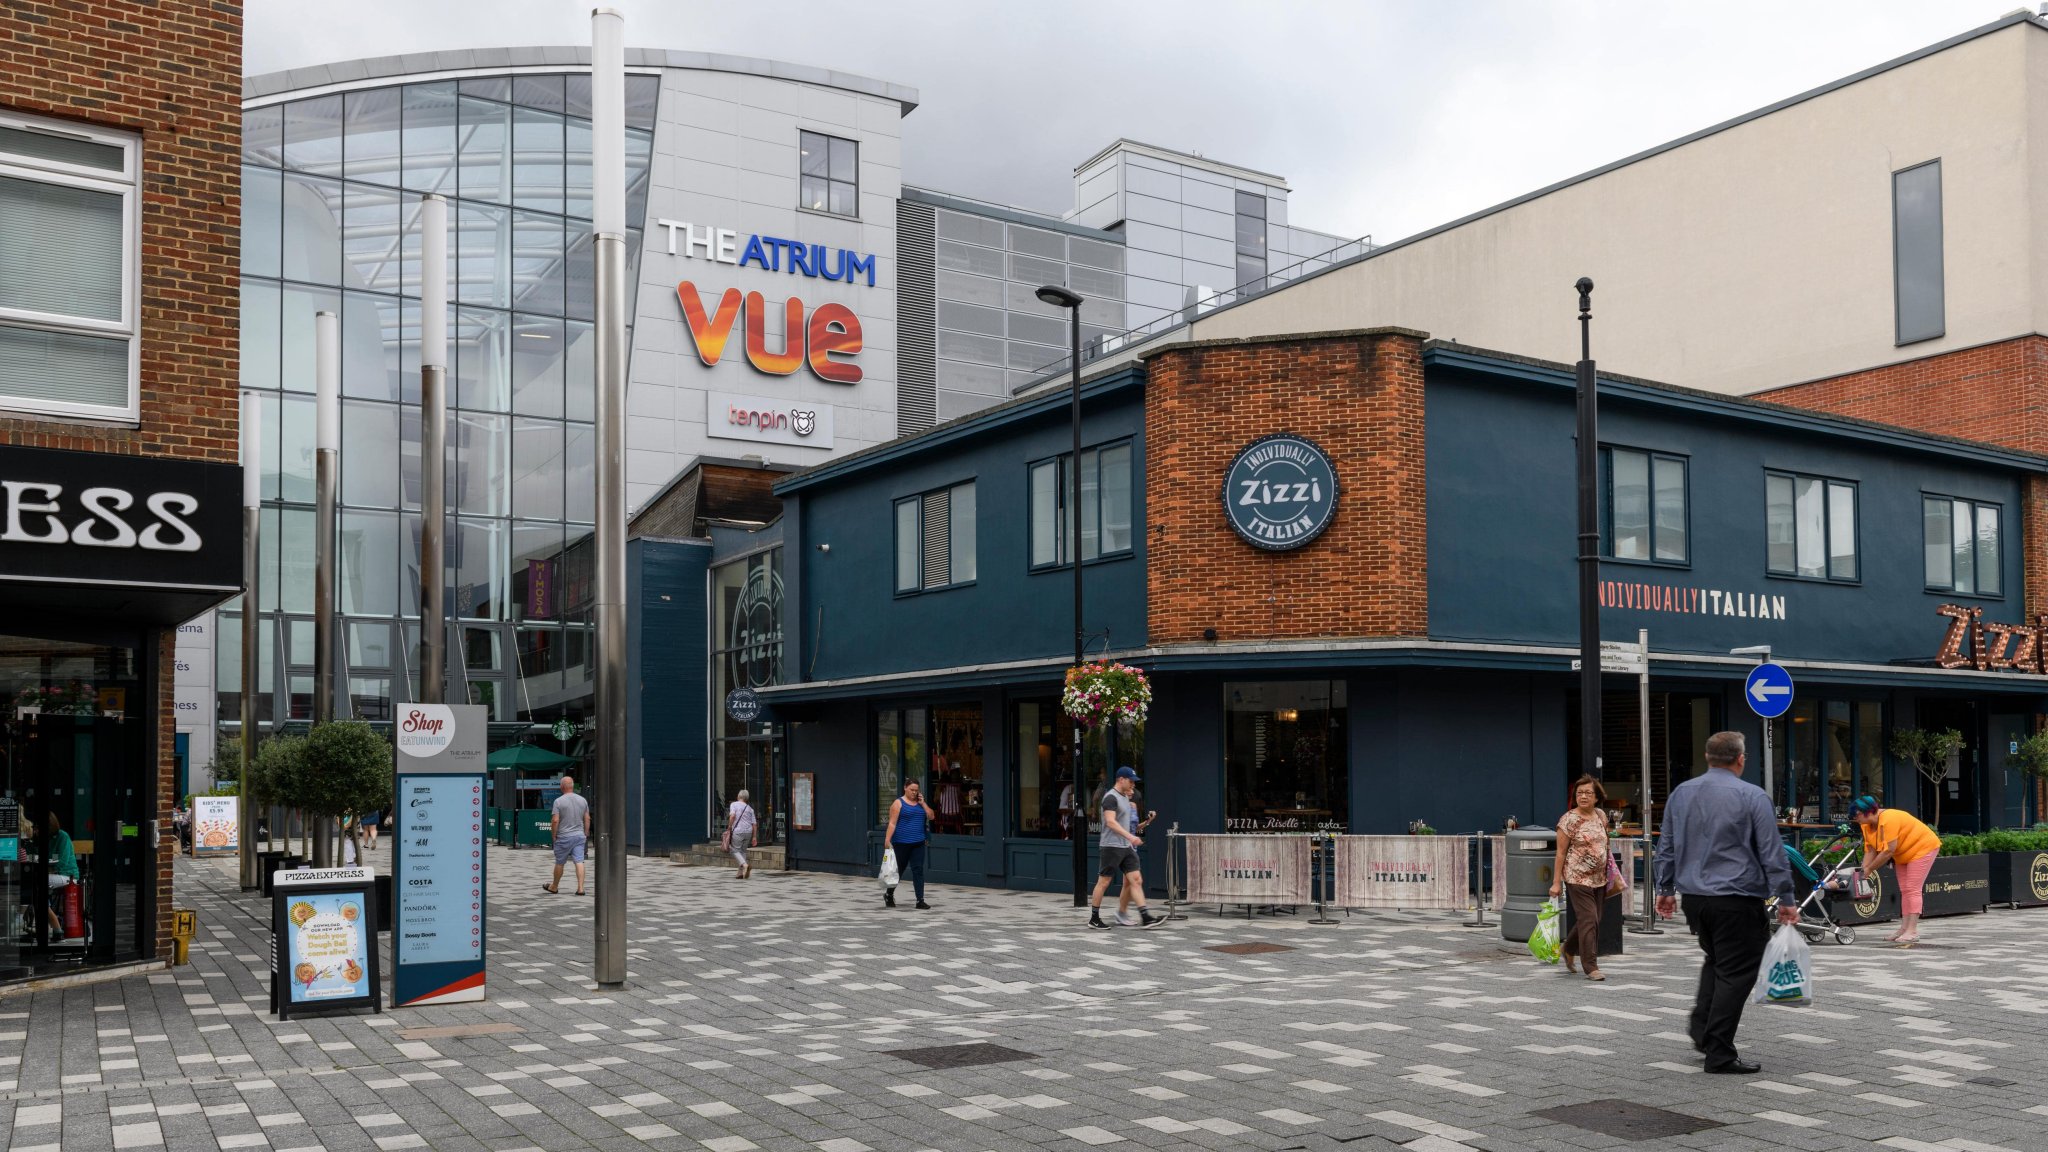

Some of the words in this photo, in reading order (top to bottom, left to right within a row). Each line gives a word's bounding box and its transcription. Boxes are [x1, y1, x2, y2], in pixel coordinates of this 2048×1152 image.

[658, 218, 737, 265] THE
[739, 234, 876, 287] ATRIUM
[728, 401, 787, 432] tenpin
[1244, 444, 1316, 471] INDIVIDUALLY
[1239, 477, 1321, 506] Zizzi
[1247, 514, 1314, 539] ITALIAN
[535, 562, 545, 615] MIMOSA
[1599, 580, 1698, 614] NDIVIDUALLY
[1701, 589, 1785, 620] ITALIAN
[732, 700, 757, 709] Zizzi
[402, 709, 444, 735] Shop
[1227, 818, 1259, 829] PIZZA
[1220, 859, 1278, 869] INDIVIDUALLY
[1370, 861, 1433, 872] INDIVIDUALLY
[285, 870, 365, 881] PIZZAEXPRESS
[1224, 869, 1272, 879] ITALIAN
[1375, 872, 1428, 883] ITALIAN
[308, 941, 332, 949] Dough
[329, 948, 348, 956] alive!
